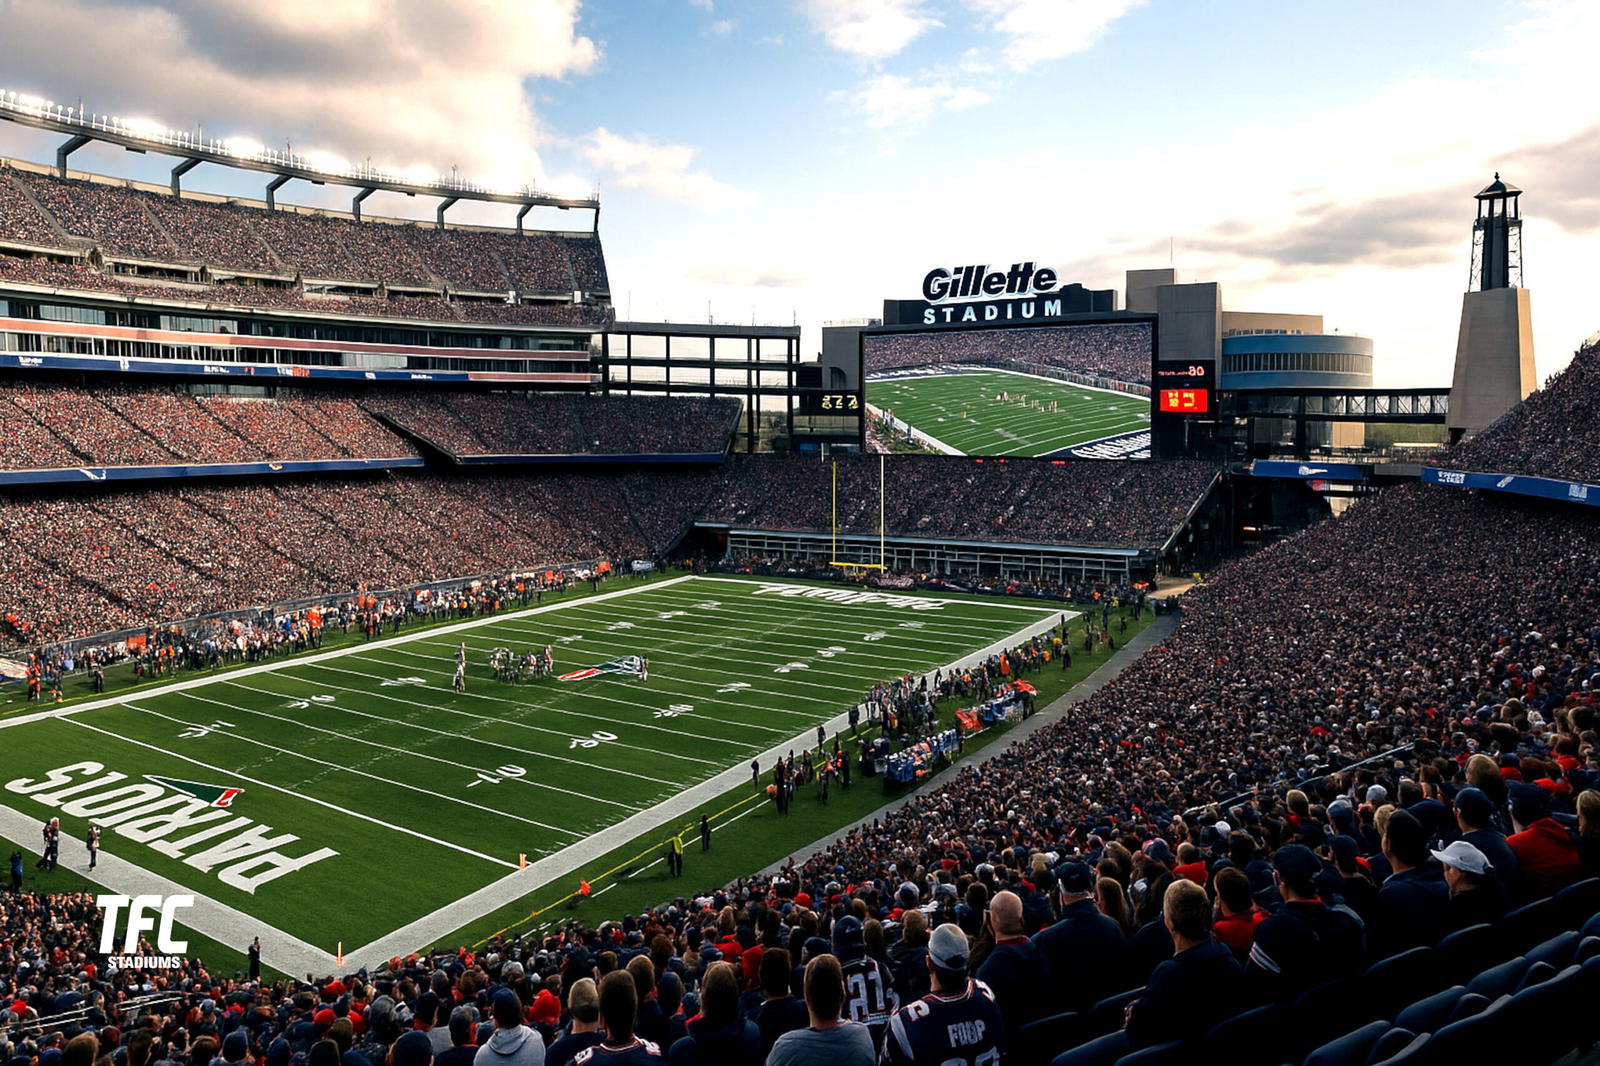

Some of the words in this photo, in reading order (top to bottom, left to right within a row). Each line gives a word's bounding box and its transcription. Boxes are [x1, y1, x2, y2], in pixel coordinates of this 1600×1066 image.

[922, 261, 1058, 301] Gillette
[923, 299, 1062, 325] STADIUM
[4, 761, 341, 895] PATRIOTS
